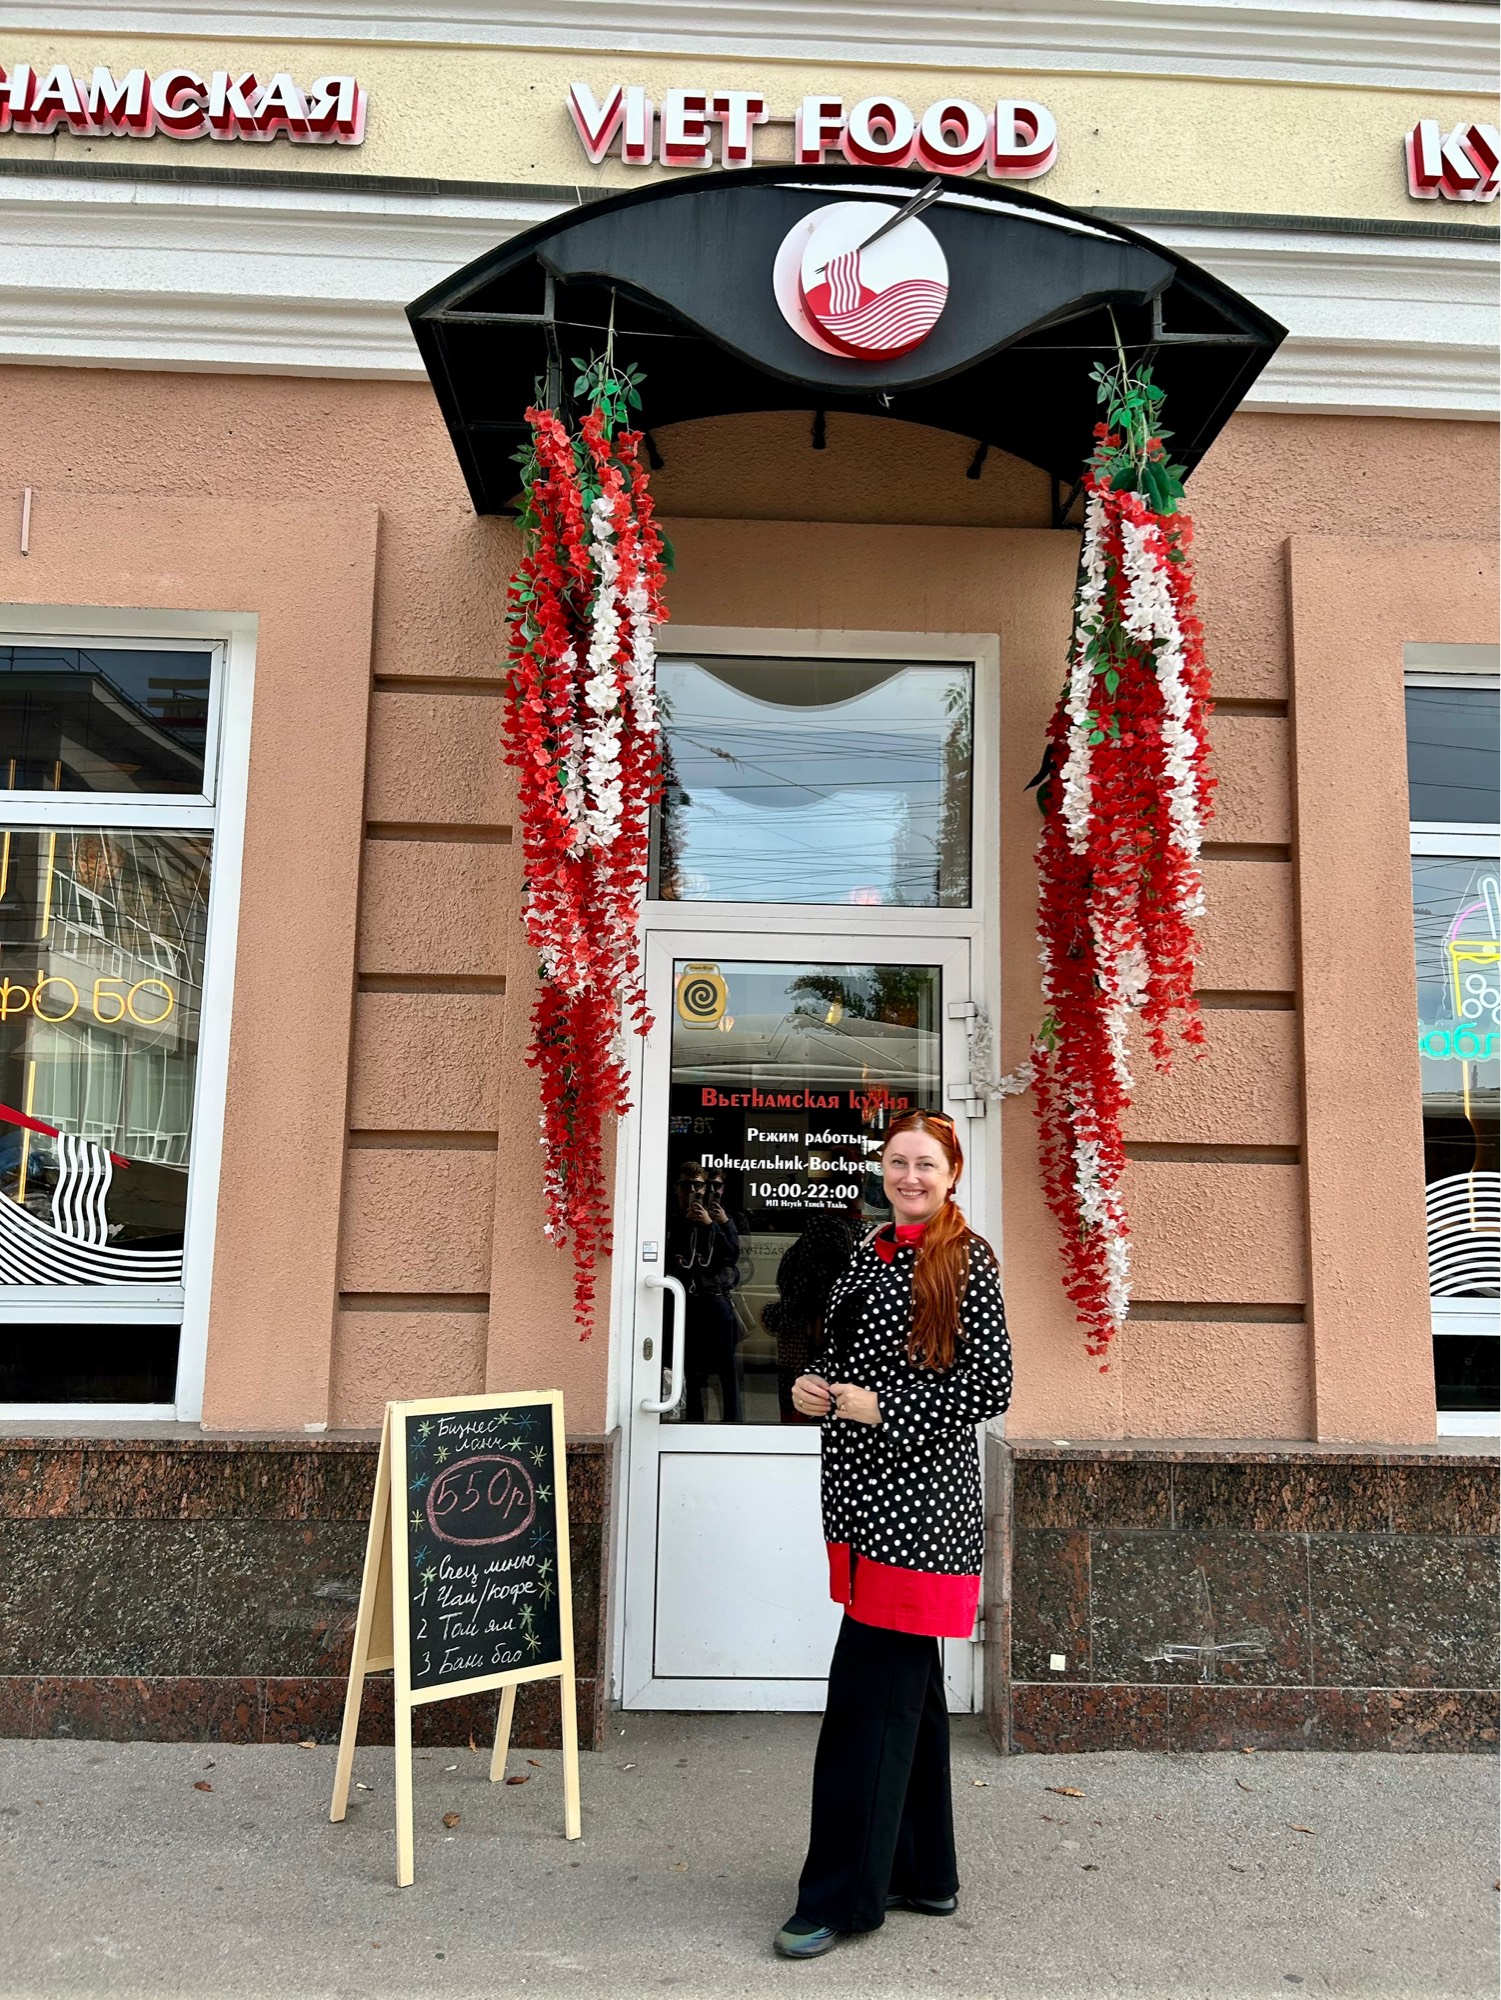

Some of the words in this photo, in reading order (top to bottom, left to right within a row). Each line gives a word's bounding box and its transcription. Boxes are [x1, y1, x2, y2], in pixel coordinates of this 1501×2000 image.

[569, 81, 765, 162] VIET
[801, 95, 1057, 170] FOOD
[93, 978, 174, 1024] БО
[849, 1089, 909, 1110] кухня
[747, 1127, 799, 1143] Режим
[749, 1182, 859, 1200] 10:00-22:00
[766, 1199, 779, 1208] ИП
[437, 1415, 500, 1439] Бизнес
[455, 1437, 510, 1453] ланч
[433, 1467, 530, 1520] 550р
[439, 1553, 480, 1585] Спец
[483, 1554, 536, 1575] меню
[413, 1586, 429, 1607] 1
[416, 1618, 428, 1640] 2
[438, 1611, 481, 1641] Том
[484, 1618, 517, 1634] ям
[416, 1650, 432, 1677] 3
[438, 1646, 484, 1675] Бань
[491, 1642, 523, 1665] бао
